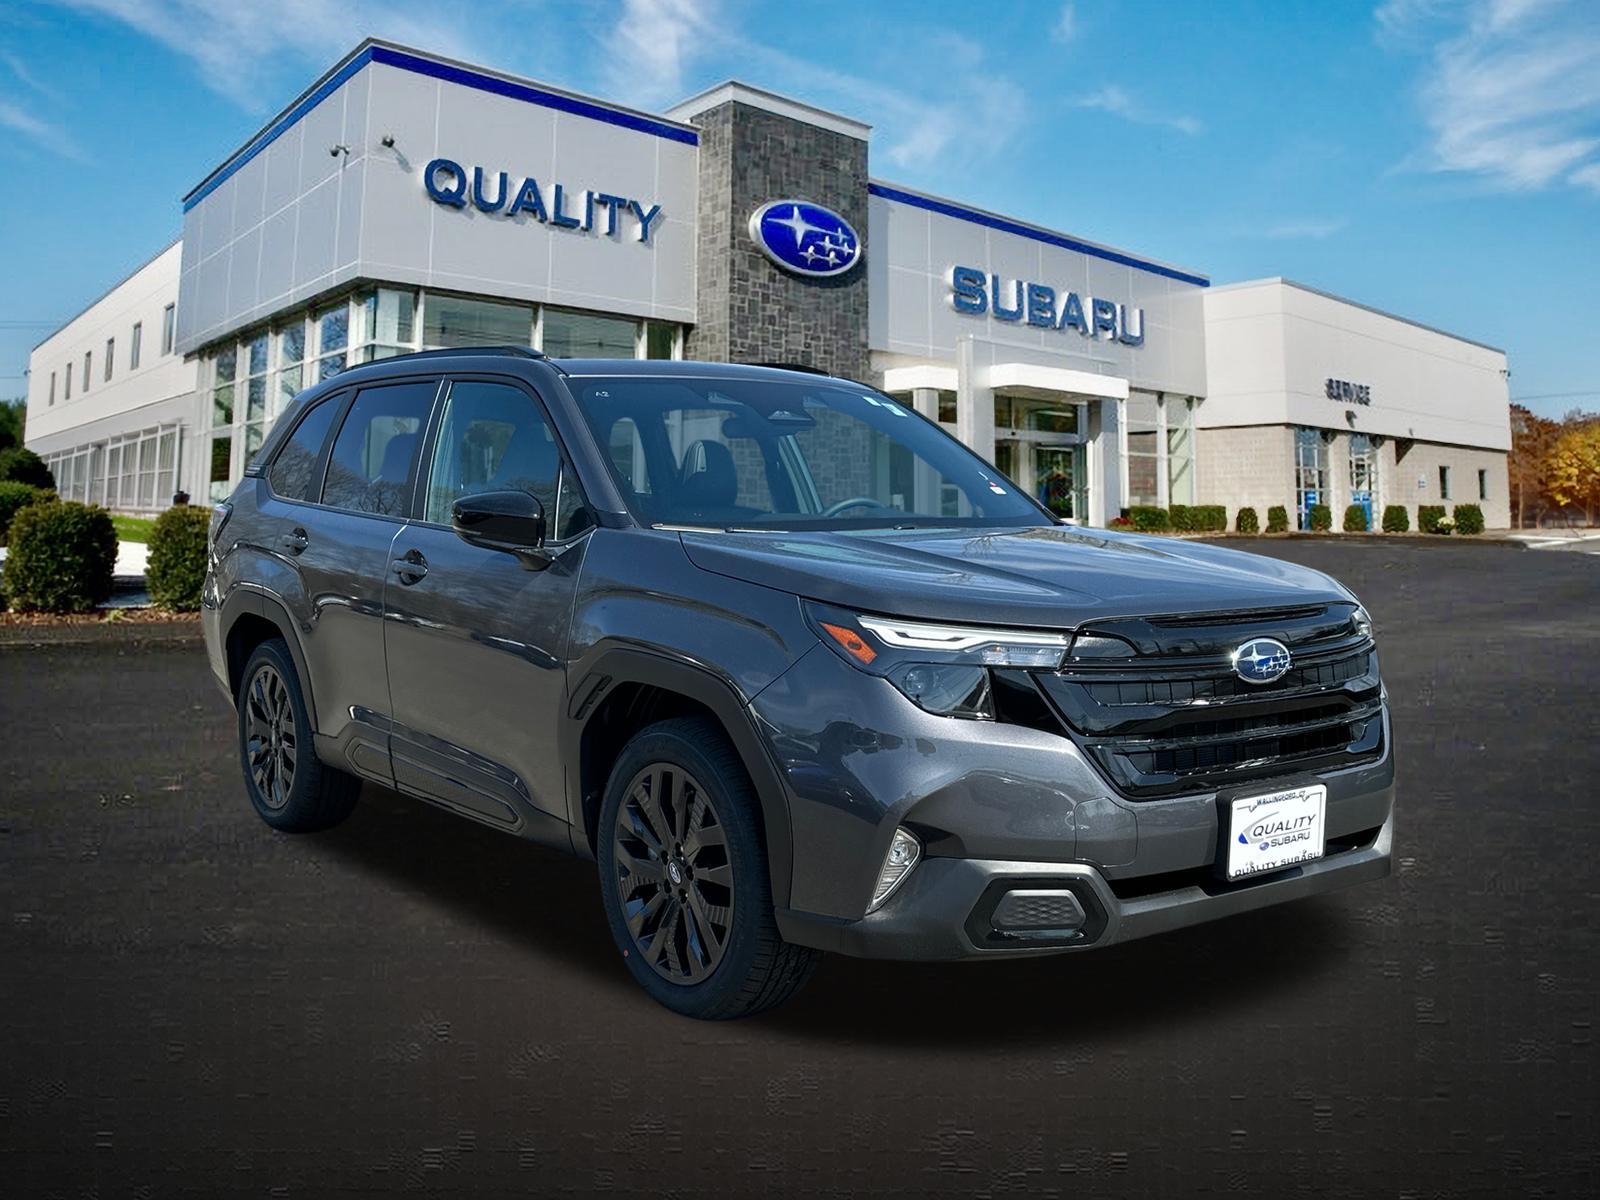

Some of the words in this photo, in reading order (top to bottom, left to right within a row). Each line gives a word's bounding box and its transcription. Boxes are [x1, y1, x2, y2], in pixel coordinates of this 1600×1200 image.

[424, 158, 661, 243] QUALITY
[952, 266, 1144, 347] SUBARU
[1325, 378, 1370, 406] SERVICE
[1252, 814, 1316, 837] QUALITY
[1270, 832, 1311, 848] SUBARU
[1234, 861, 1277, 876] QUALITY
[1280, 851, 1320, 866] SUBARU
